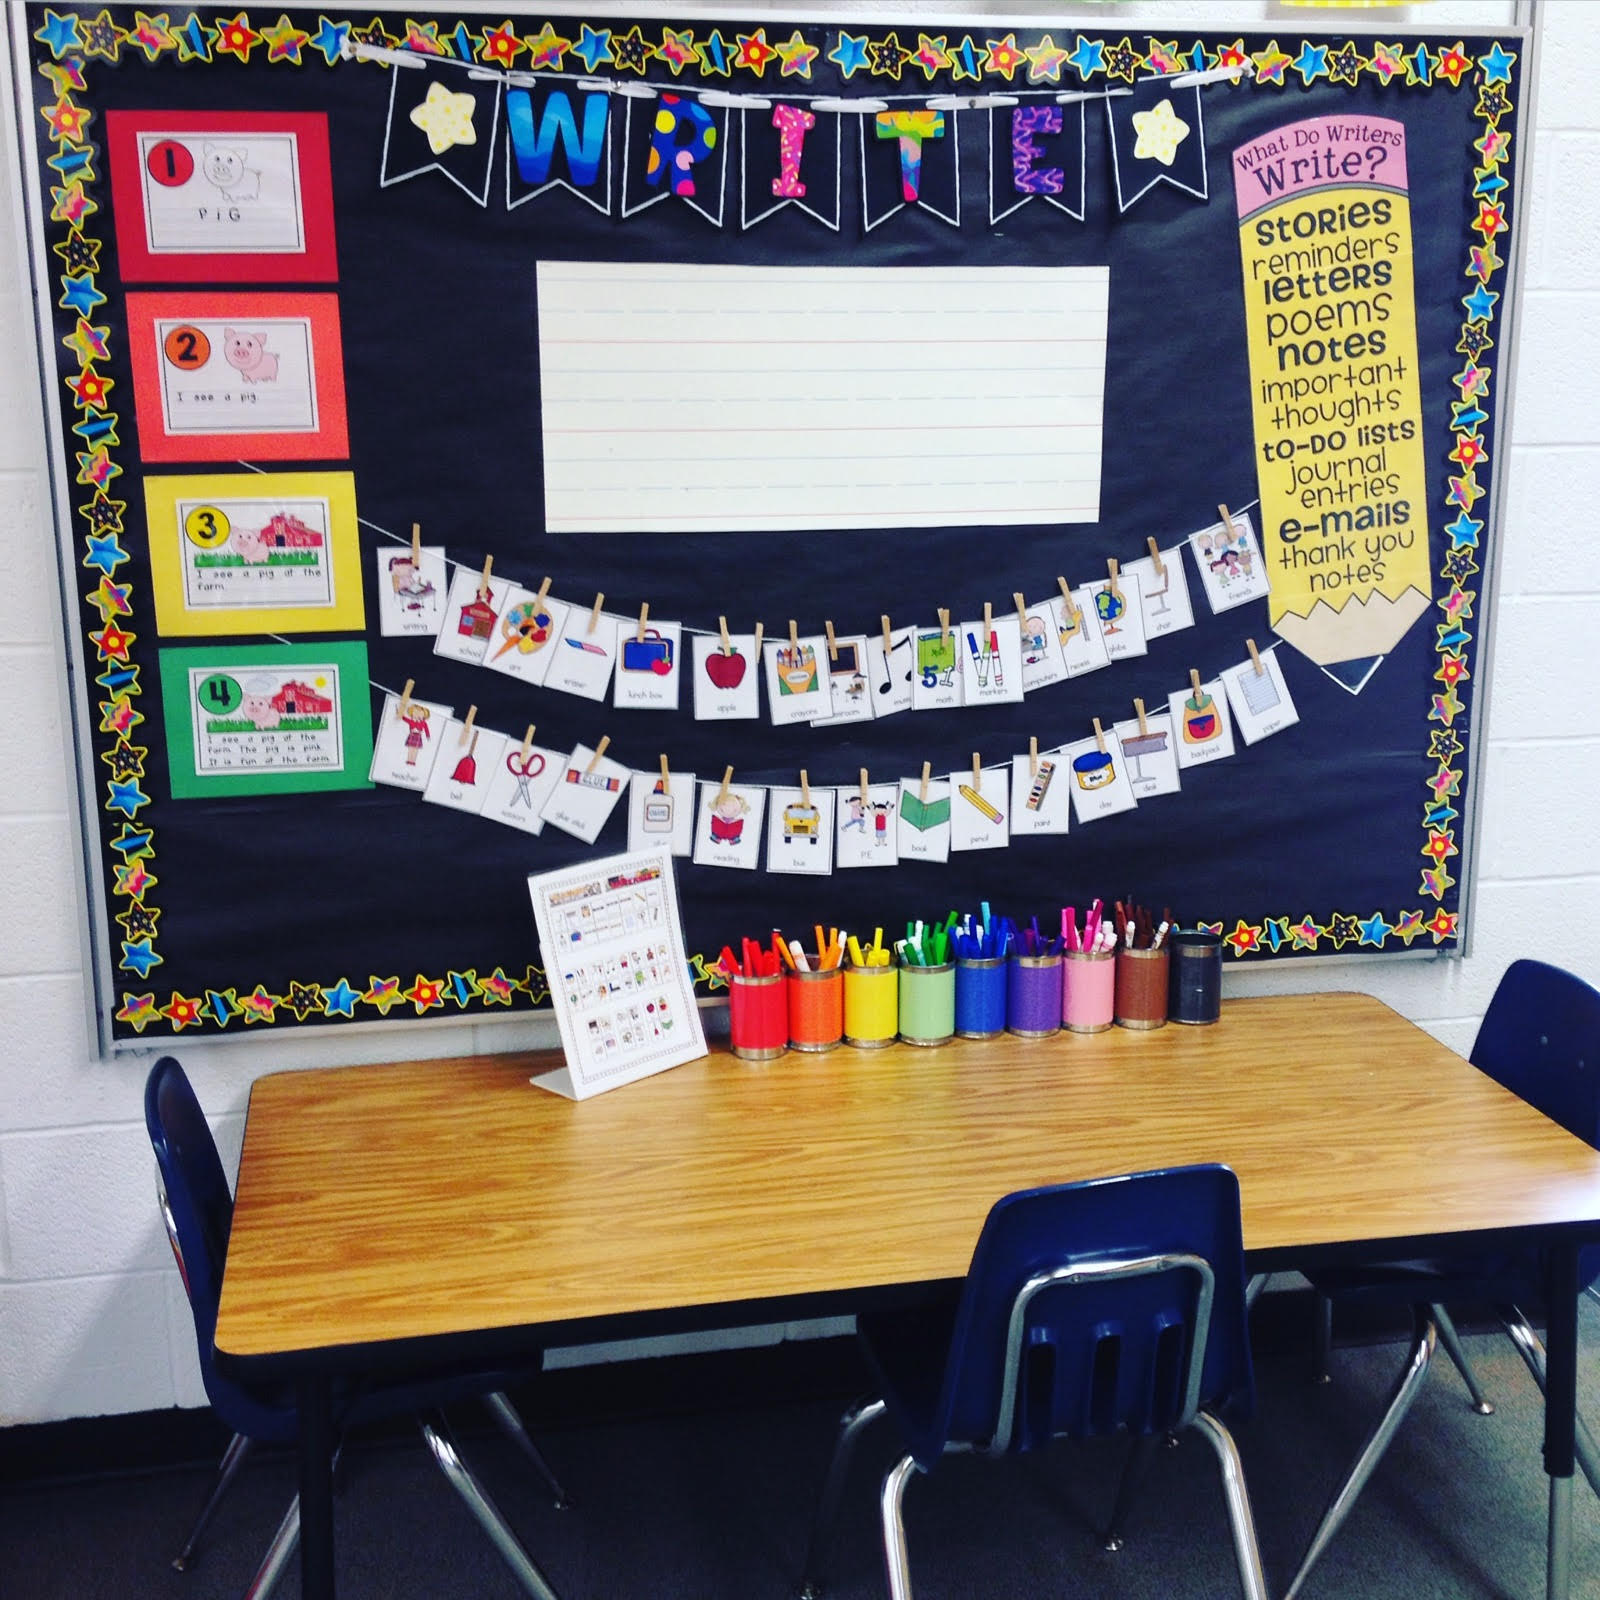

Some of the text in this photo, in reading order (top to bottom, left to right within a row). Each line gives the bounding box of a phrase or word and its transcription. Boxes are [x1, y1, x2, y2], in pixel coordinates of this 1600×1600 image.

[165, 147, 176, 178] 1
[506, 90, 1064, 203] WRITE
[1236, 125, 1402, 171] What Do Writers
[1252, 145, 1388, 196] Write?
[1252, 232, 1401, 281] reminders
[1266, 292, 1393, 346] poems
[176, 332, 199, 361] 2
[1277, 329, 1387, 372] notes
[177, 391, 183, 402] I
[194, 393, 215, 402] see
[224, 393, 232, 401] a
[1261, 356, 1408, 404] important
[1271, 388, 1403, 430] thoughts
[1357, 419, 1416, 447] lists
[1285, 446, 1388, 496] journal
[1300, 473, 1401, 509] entries
[197, 511, 218, 540] 3
[1279, 500, 1411, 544] e-mails
[1279, 530, 1414, 570] thank you
[197, 569, 203, 579] I
[213, 571, 233, 579] see
[243, 570, 250, 578] a
[259, 569, 275, 580] pig
[303, 568, 322, 577] the
[1309, 562, 1387, 593] notes
[921, 664, 939, 688] 5
[208, 679, 231, 707] 4
[261, 735, 276, 744] pig
[300, 733, 316, 741] the
[265, 745, 280, 753] pig
[241, 757, 257, 766] fun
[282, 755, 298, 764] the
